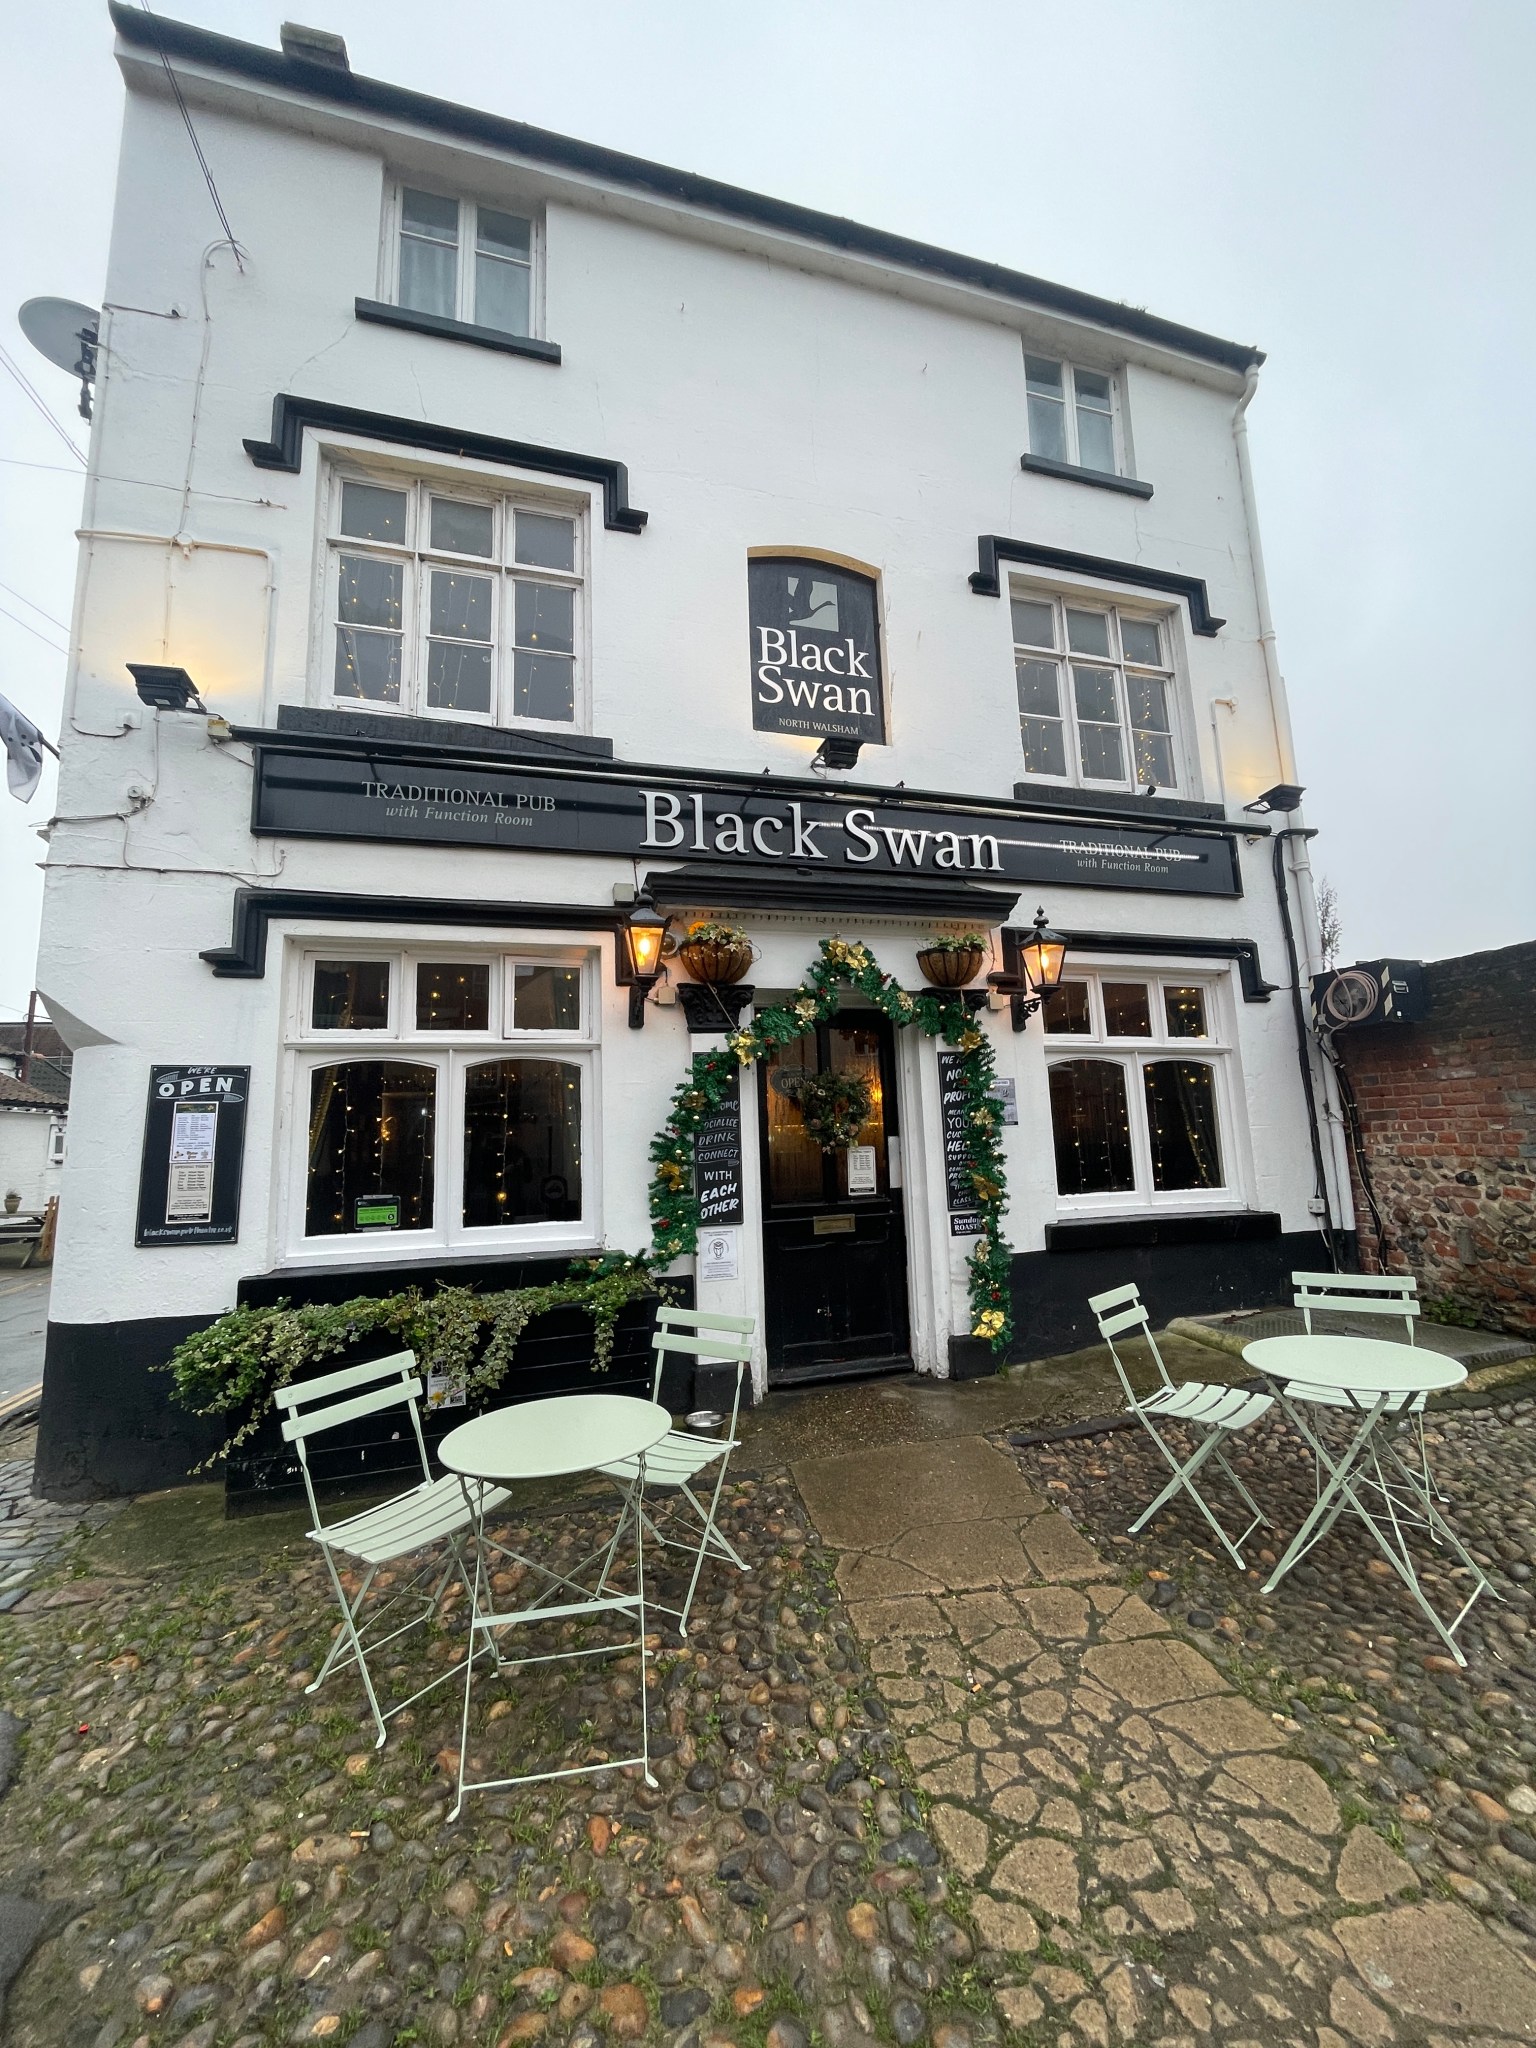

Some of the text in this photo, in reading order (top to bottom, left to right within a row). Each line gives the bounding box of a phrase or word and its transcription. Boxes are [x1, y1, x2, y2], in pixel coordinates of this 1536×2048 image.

[756, 625, 873, 679] Black
[758, 665, 875, 716] Swan
[778, 717, 859, 735] NORTH WALSHAM
[361, 781, 556, 812] TRADITIONAL PUB
[385, 805, 533, 826] with Function Room
[639, 790, 1005, 871] Black Swan
[1060, 839, 1182, 862] TRADITIONAL PUB
[1077, 857, 1169, 874] with Function Room
[941, 1055, 955, 1064] WE
[187, 1066, 218, 1075] WE'RE
[158, 1077, 233, 1097] OPEN
[698, 1132, 736, 1146] DRINK
[698, 1148, 739, 1162] CONNECT
[704, 1170, 732, 1181] WITH
[700, 1182, 738, 1203] EACH
[700, 1198, 740, 1220] OTHER
